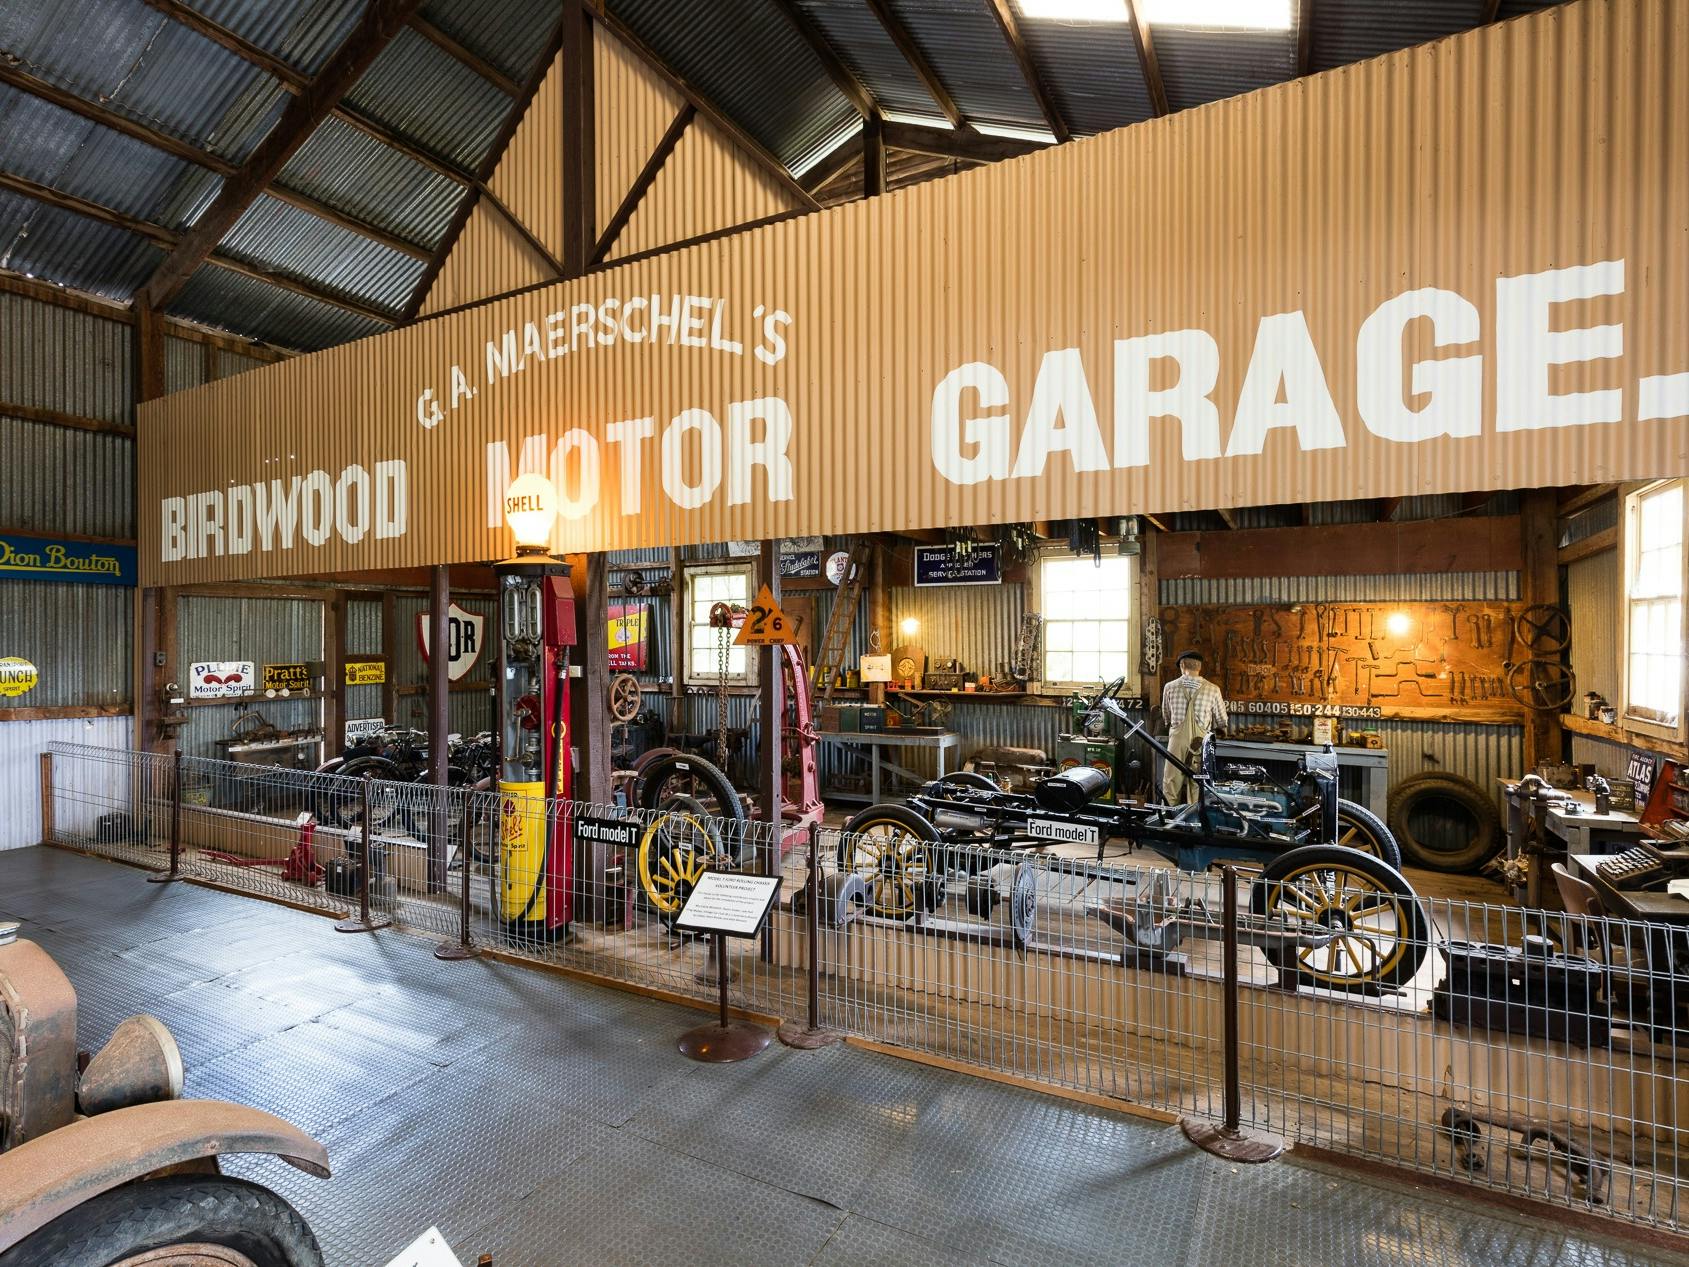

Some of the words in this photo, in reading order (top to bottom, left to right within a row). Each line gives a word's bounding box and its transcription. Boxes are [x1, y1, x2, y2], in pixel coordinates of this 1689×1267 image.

[161, 459, 407, 562] BIRDWOOD
[486, 396, 794, 529] MOTOR
[506, 494, 544, 514] SHELL
[45, 544, 122, 577] Bouton
[800, 569, 819, 577] STATION
[616, 618, 639, 627] TRPLE
[357, 664, 385, 673] NATIONAL
[265, 680, 288, 690] Motor
[358, 673, 385, 682] BENZINE
[194, 685, 223, 694] Motor
[226, 683, 252, 693] Spirit
[1248, 702, 1288, 714] 60405
[1627, 760, 1652, 784] ATLAS
[501, 814, 524, 841] Shell
[578, 820, 599, 839] Ford
[600, 826, 629, 843] model
[631, 827, 638, 844] T
[1029, 821, 1052, 836] Ford
[1055, 827, 1087, 842] model
[1090, 829, 1097, 843] T
